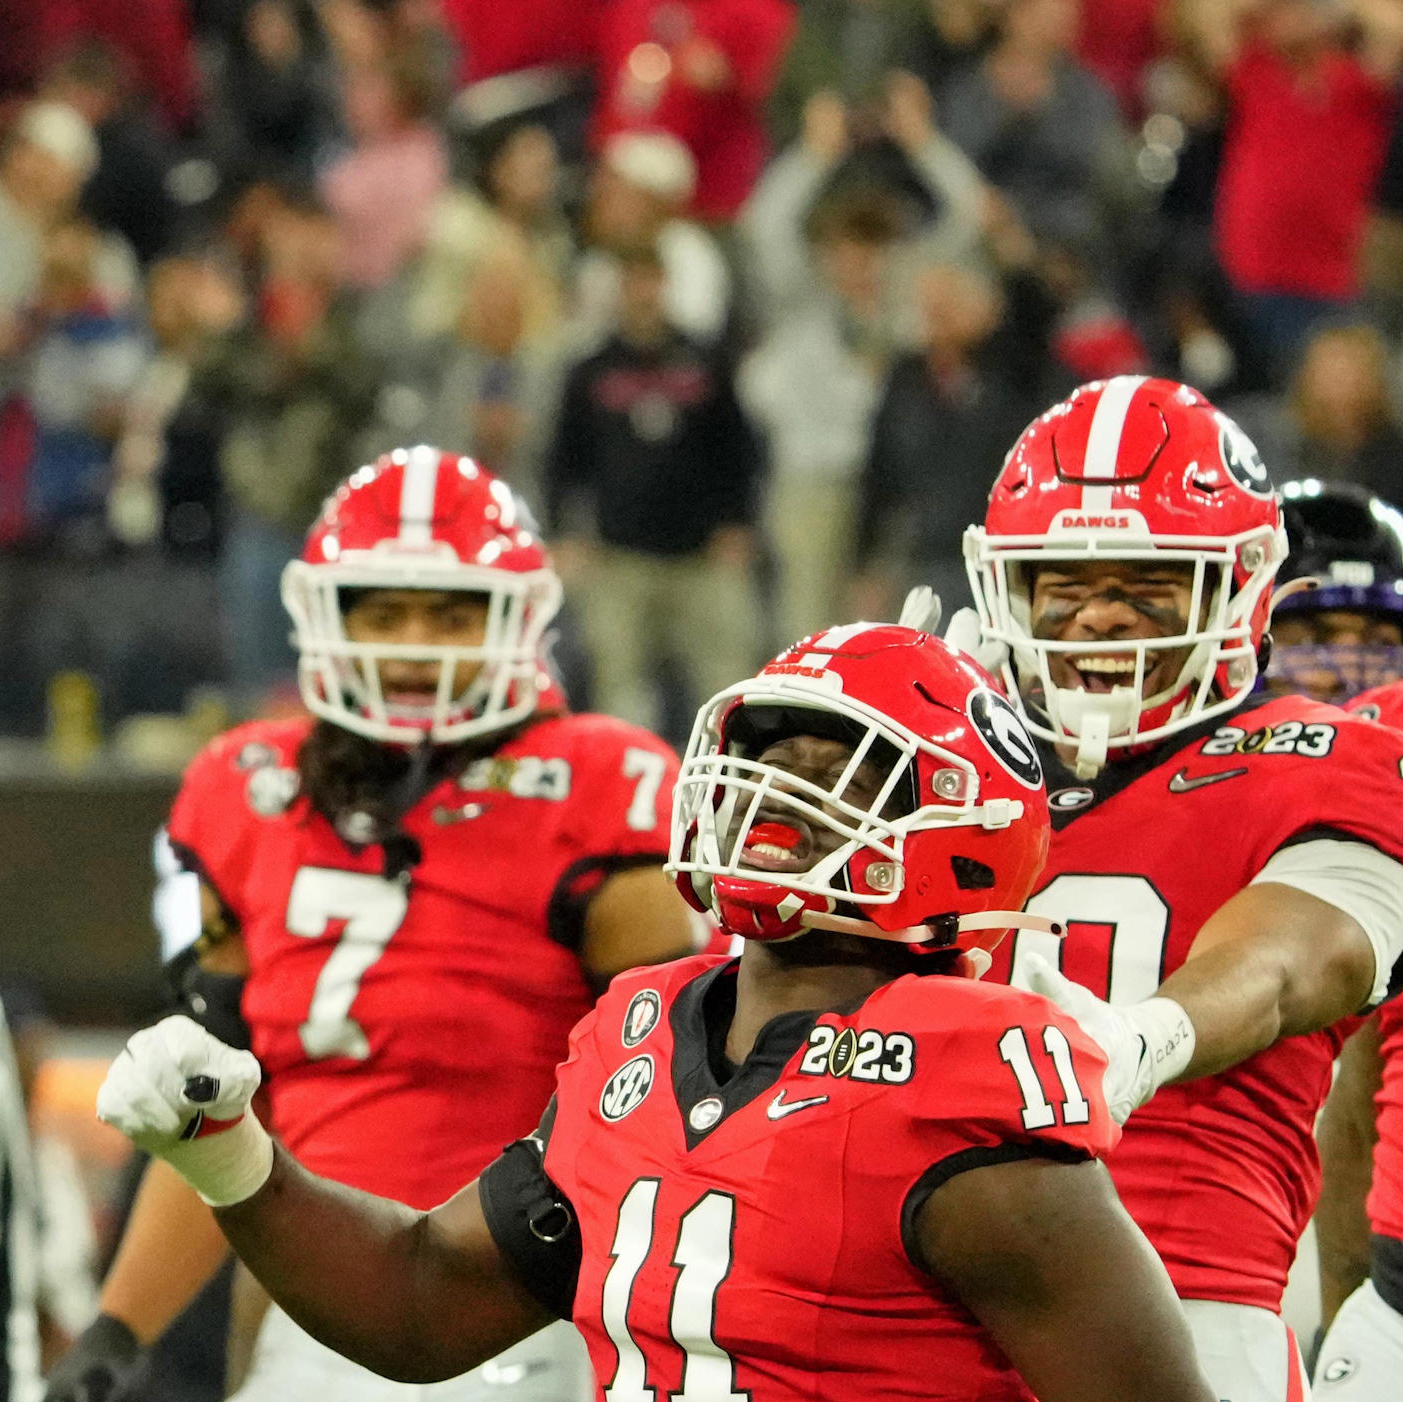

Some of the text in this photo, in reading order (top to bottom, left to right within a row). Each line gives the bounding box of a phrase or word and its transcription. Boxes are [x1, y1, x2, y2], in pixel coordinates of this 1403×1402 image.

[1061, 515, 1131, 530] DAWGS
[764, 664, 826, 679] DAWGS
[622, 747, 666, 831] 7
[285, 865, 410, 1061] 7
[799, 1024, 917, 1086] 2023
[1000, 1024, 1090, 1131] 11
[601, 1056, 653, 1119] SEC
